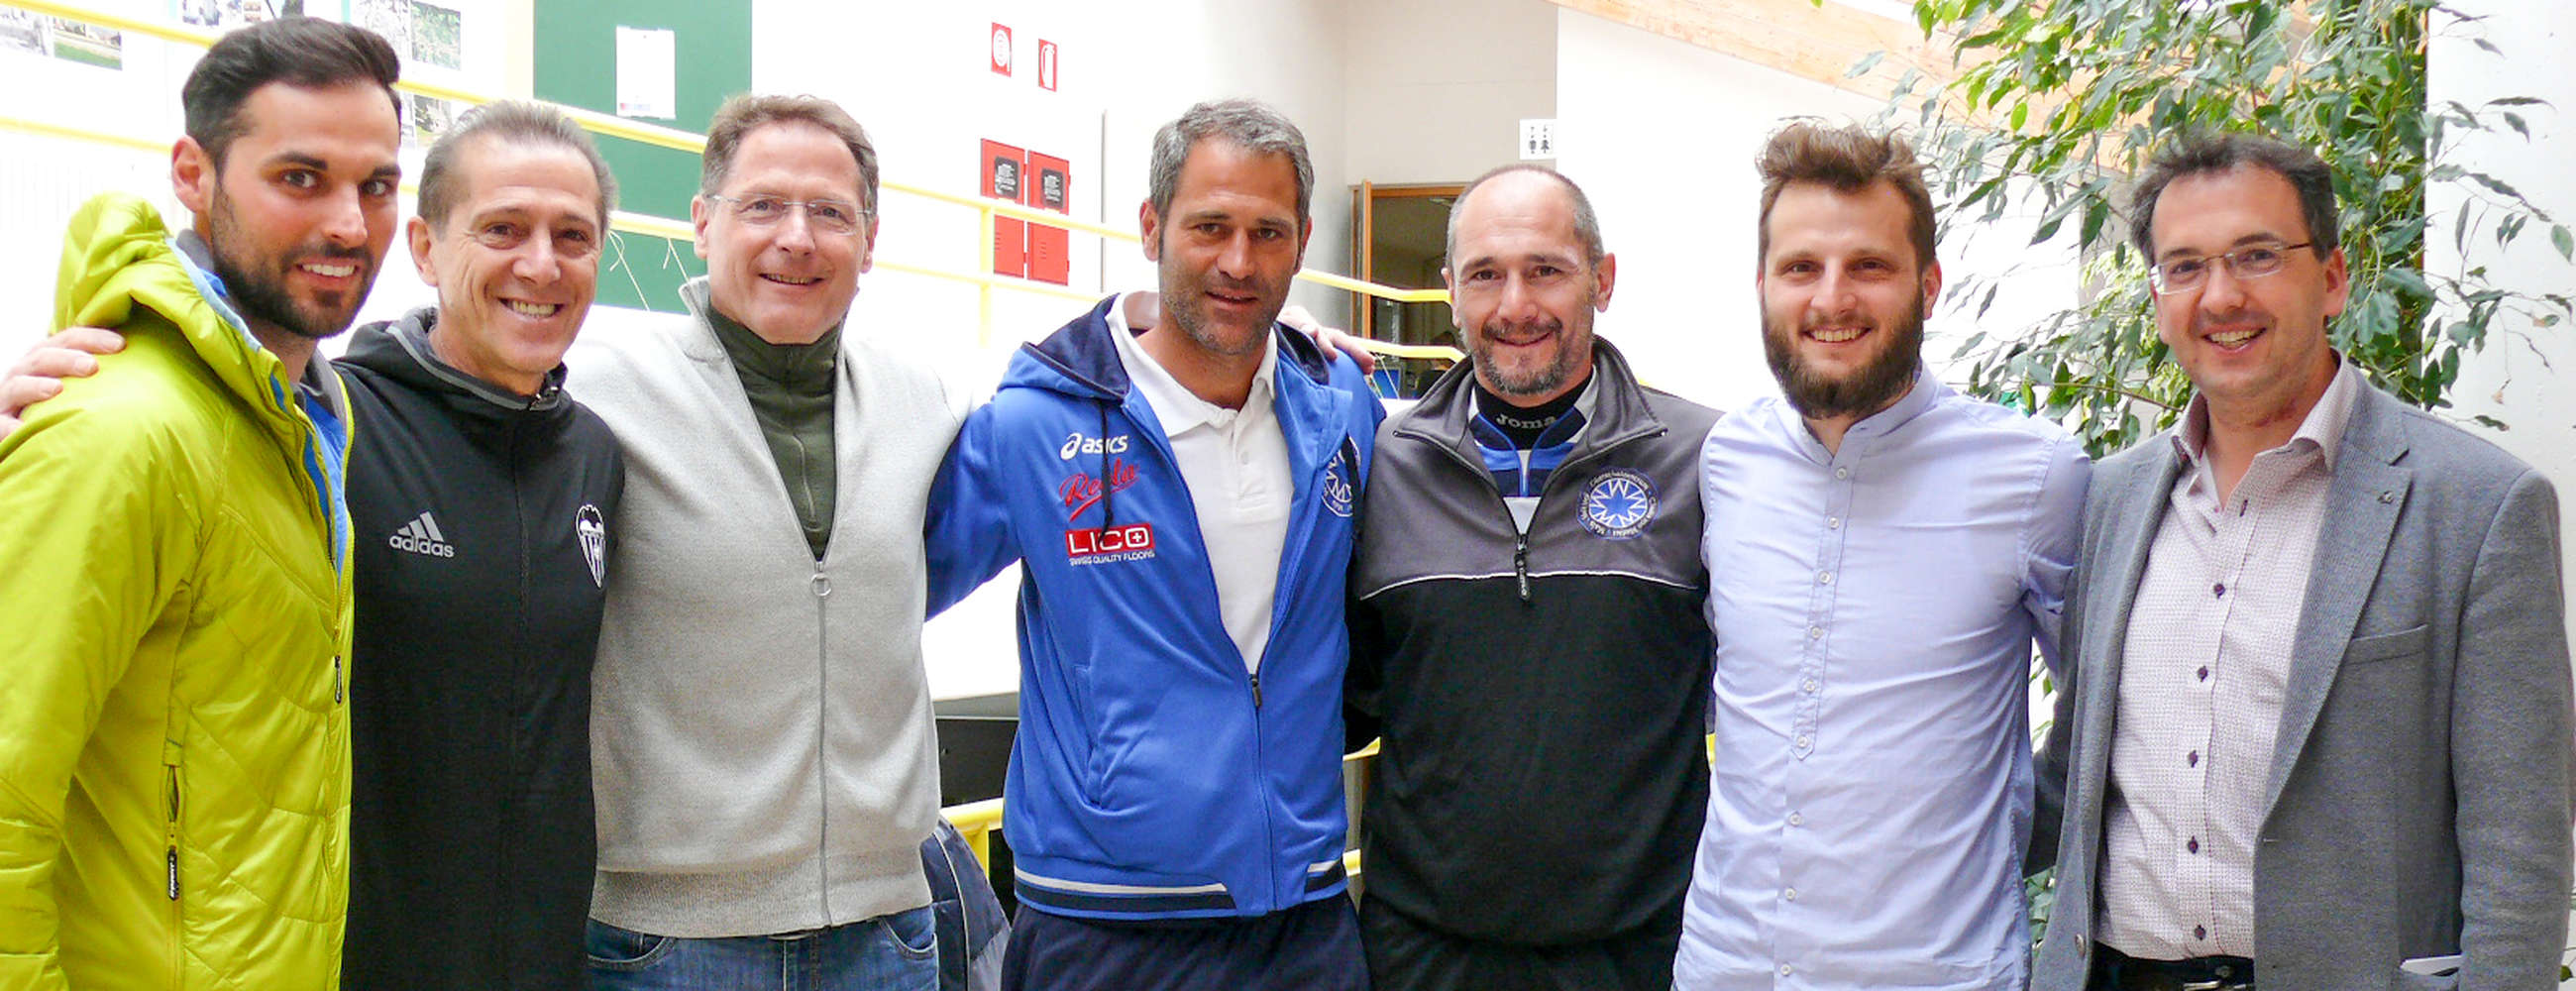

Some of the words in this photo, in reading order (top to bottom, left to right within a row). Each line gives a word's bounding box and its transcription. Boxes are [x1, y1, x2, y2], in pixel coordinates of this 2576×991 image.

[1495, 413, 1556, 430] Joma
[1081, 434, 1128, 455] asics
[388, 535, 455, 558] adidas
[1068, 527, 1149, 554] LICO
[1092, 552, 1122, 565] QUALITY
